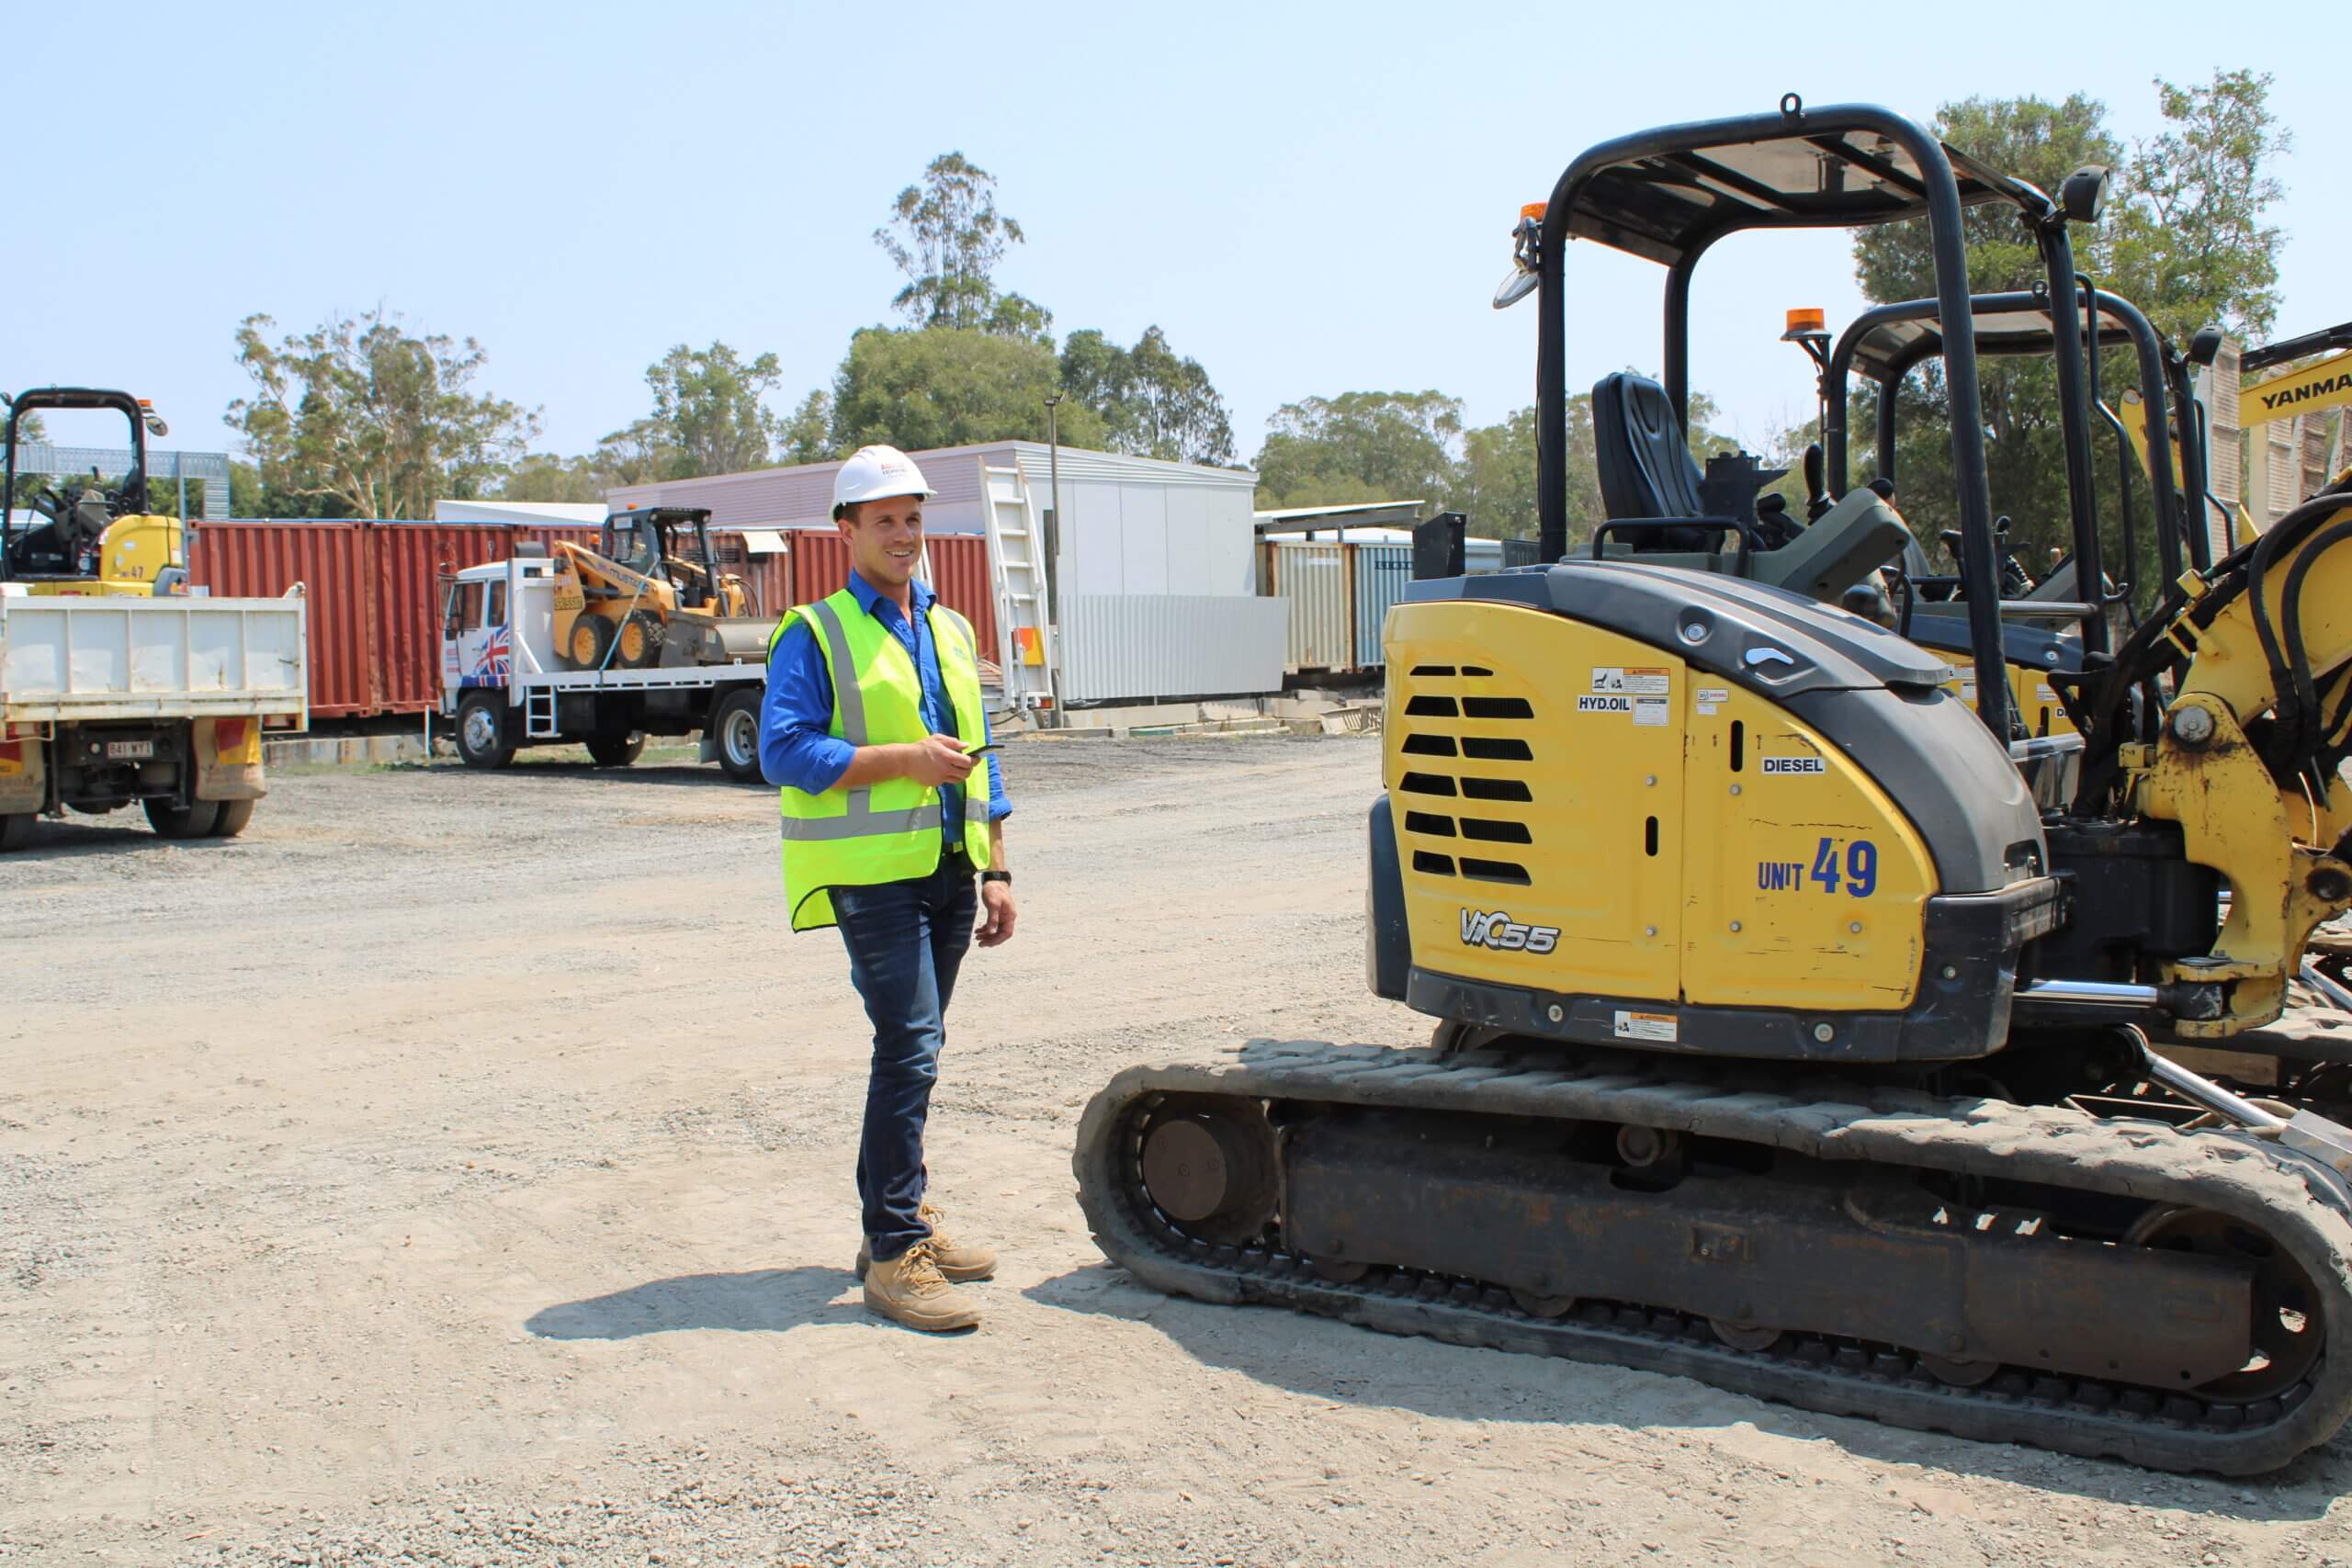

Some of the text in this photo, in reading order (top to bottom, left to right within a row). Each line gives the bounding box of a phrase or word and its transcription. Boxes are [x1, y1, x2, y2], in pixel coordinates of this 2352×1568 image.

[131, 566, 144, 579] 47
[1579, 697, 1630, 710] HYD.OIL
[1764, 759, 1823, 772] DIESEL
[1758, 838, 1877, 897] UNIT 49
